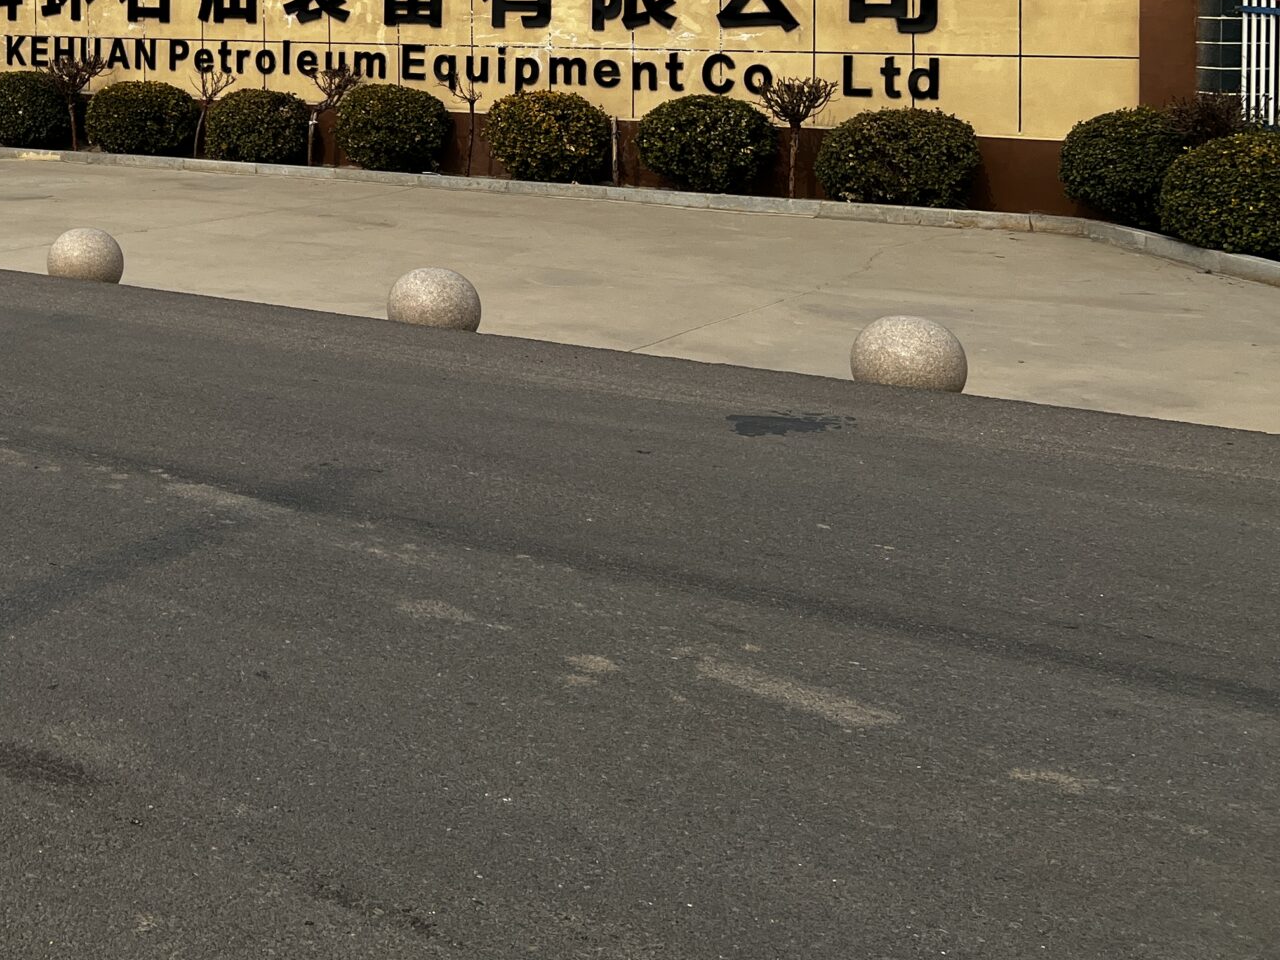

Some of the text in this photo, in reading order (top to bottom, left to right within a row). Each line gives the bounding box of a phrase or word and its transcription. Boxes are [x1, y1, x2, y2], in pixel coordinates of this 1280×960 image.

[6, 35, 157, 71] KEHUAN
[169, 40, 387, 79] Petroleum
[402, 44, 685, 94] Equipment
[843, 55, 939, 100] Ltd
